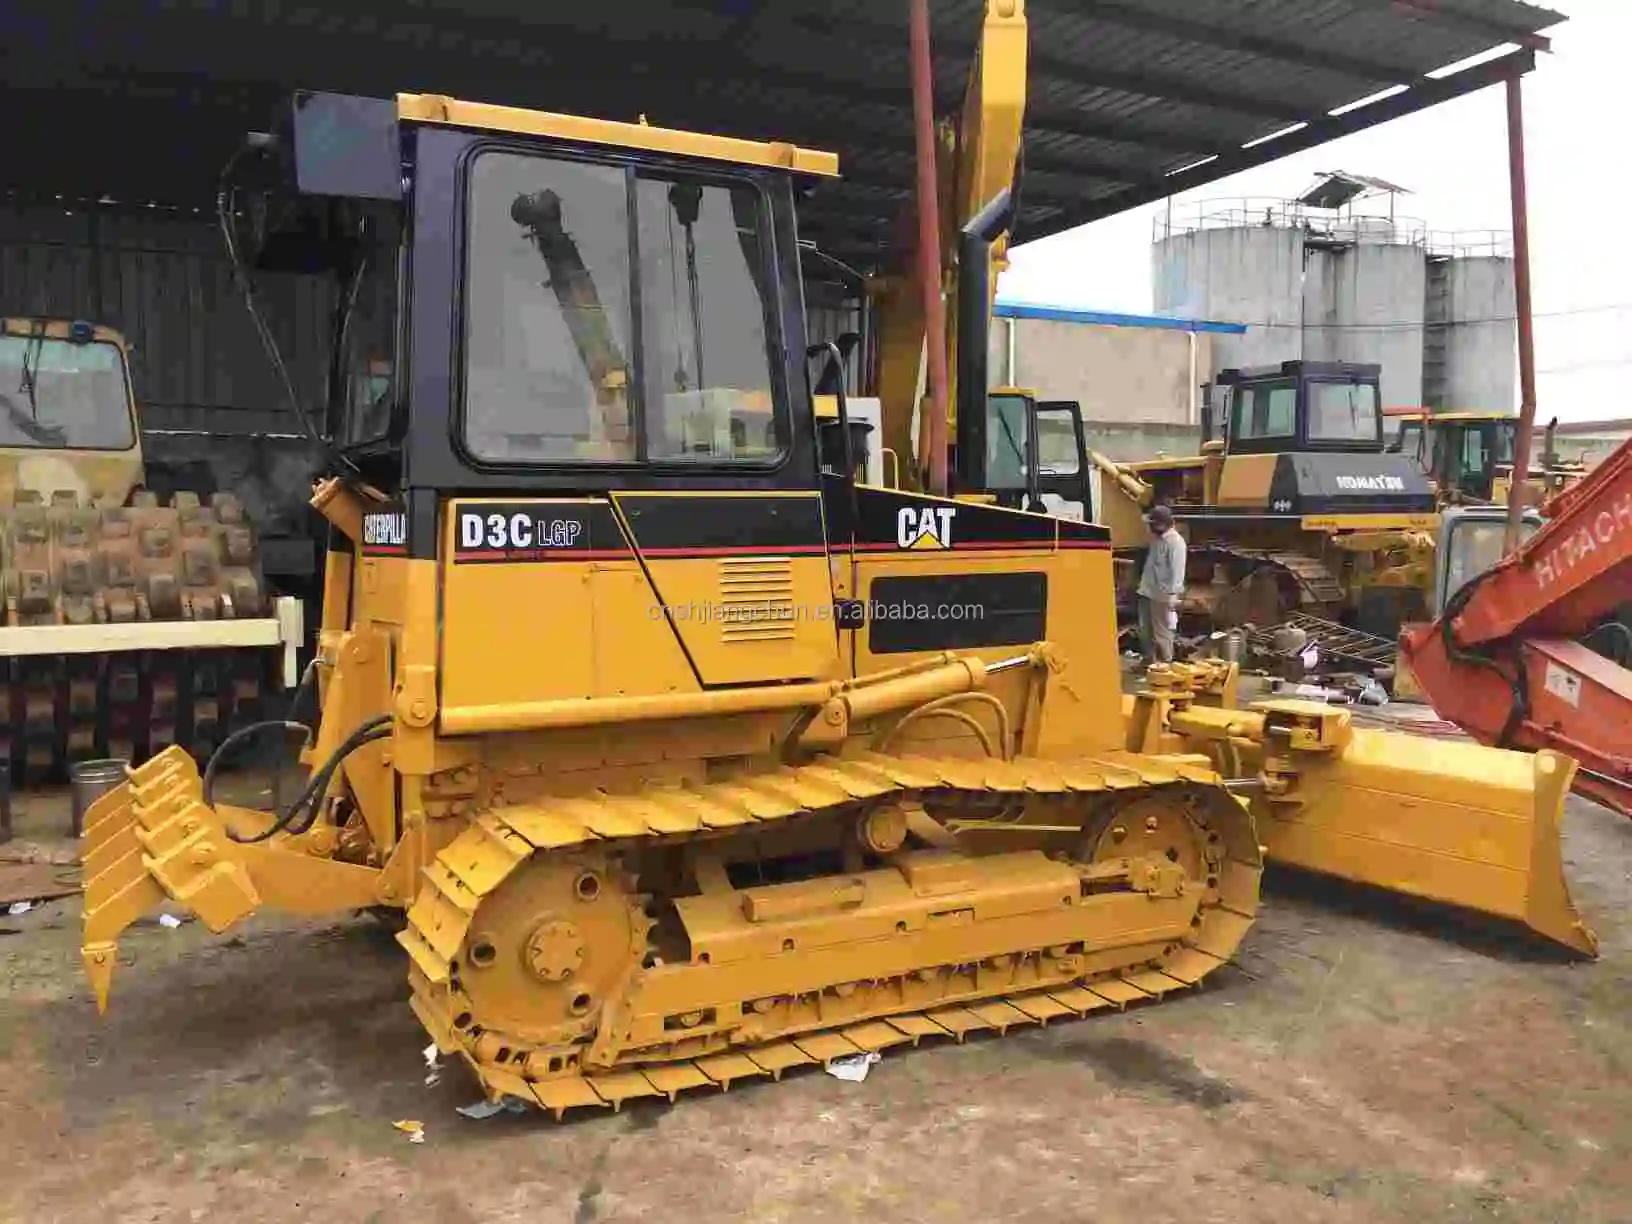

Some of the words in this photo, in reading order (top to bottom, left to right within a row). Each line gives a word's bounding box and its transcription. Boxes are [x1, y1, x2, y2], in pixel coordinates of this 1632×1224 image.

[364, 513, 406, 544] CATERPILLA
[462, 513, 532, 547] D3C
[537, 520, 581, 547] LGP
[897, 507, 956, 549] CAT
[1535, 492, 1632, 591] HITACH
